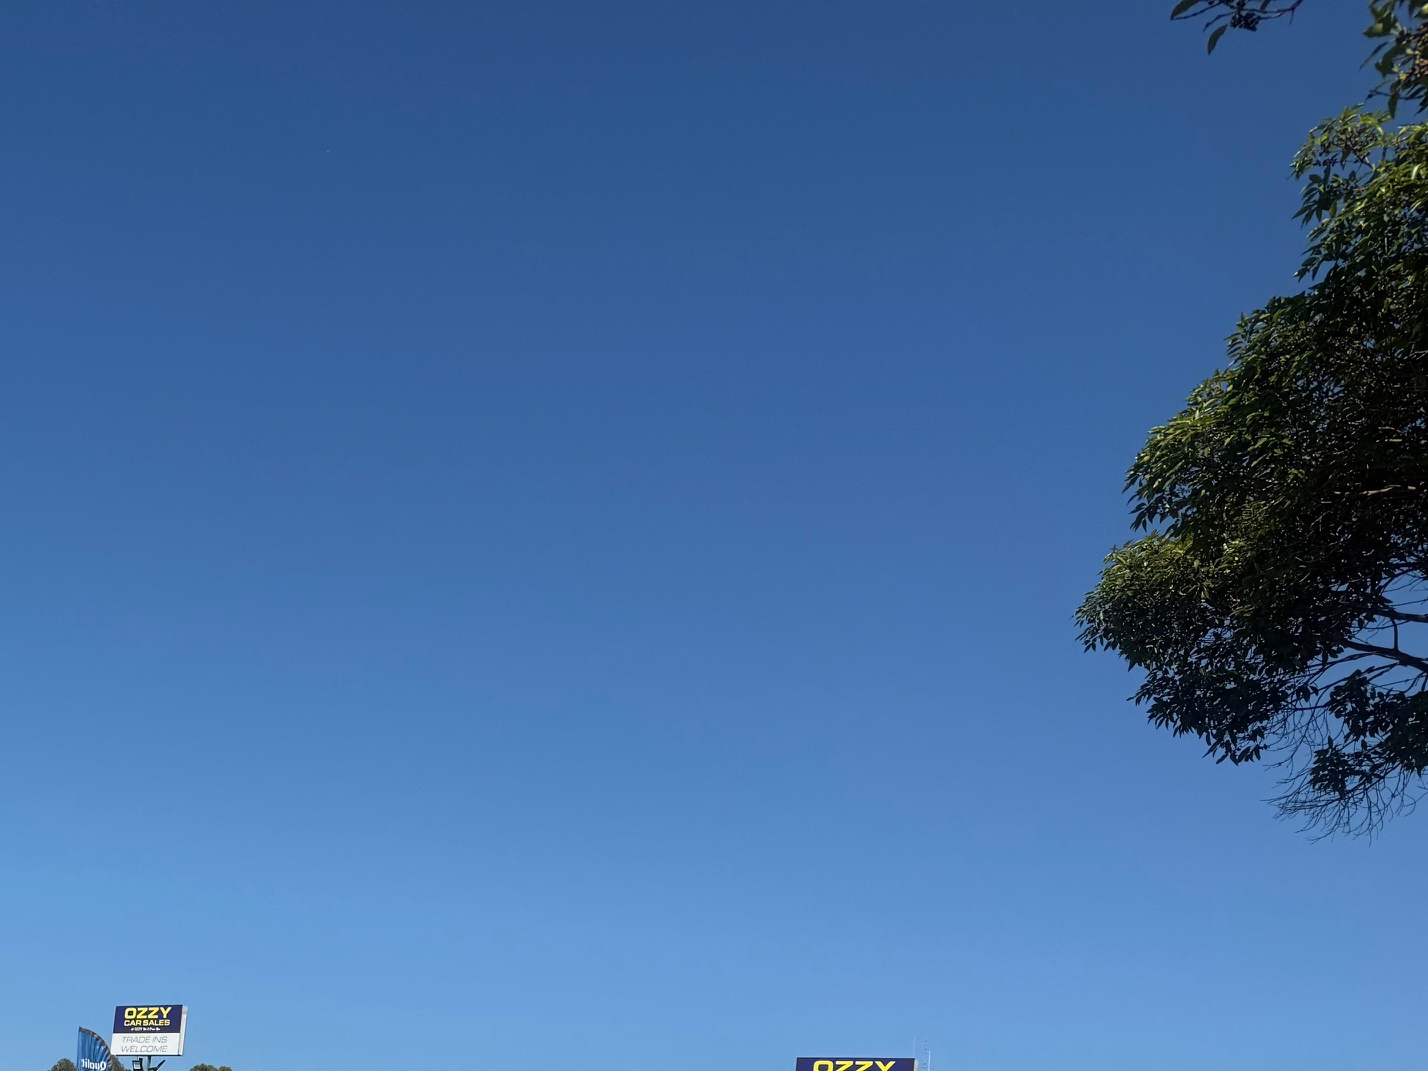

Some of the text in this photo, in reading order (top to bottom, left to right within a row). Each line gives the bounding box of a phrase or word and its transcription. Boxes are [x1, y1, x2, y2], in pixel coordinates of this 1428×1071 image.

[124, 1007, 172, 1019] OZZY
[122, 1036, 151, 1044] TRADE
[121, 1045, 169, 1053] WELCOME
